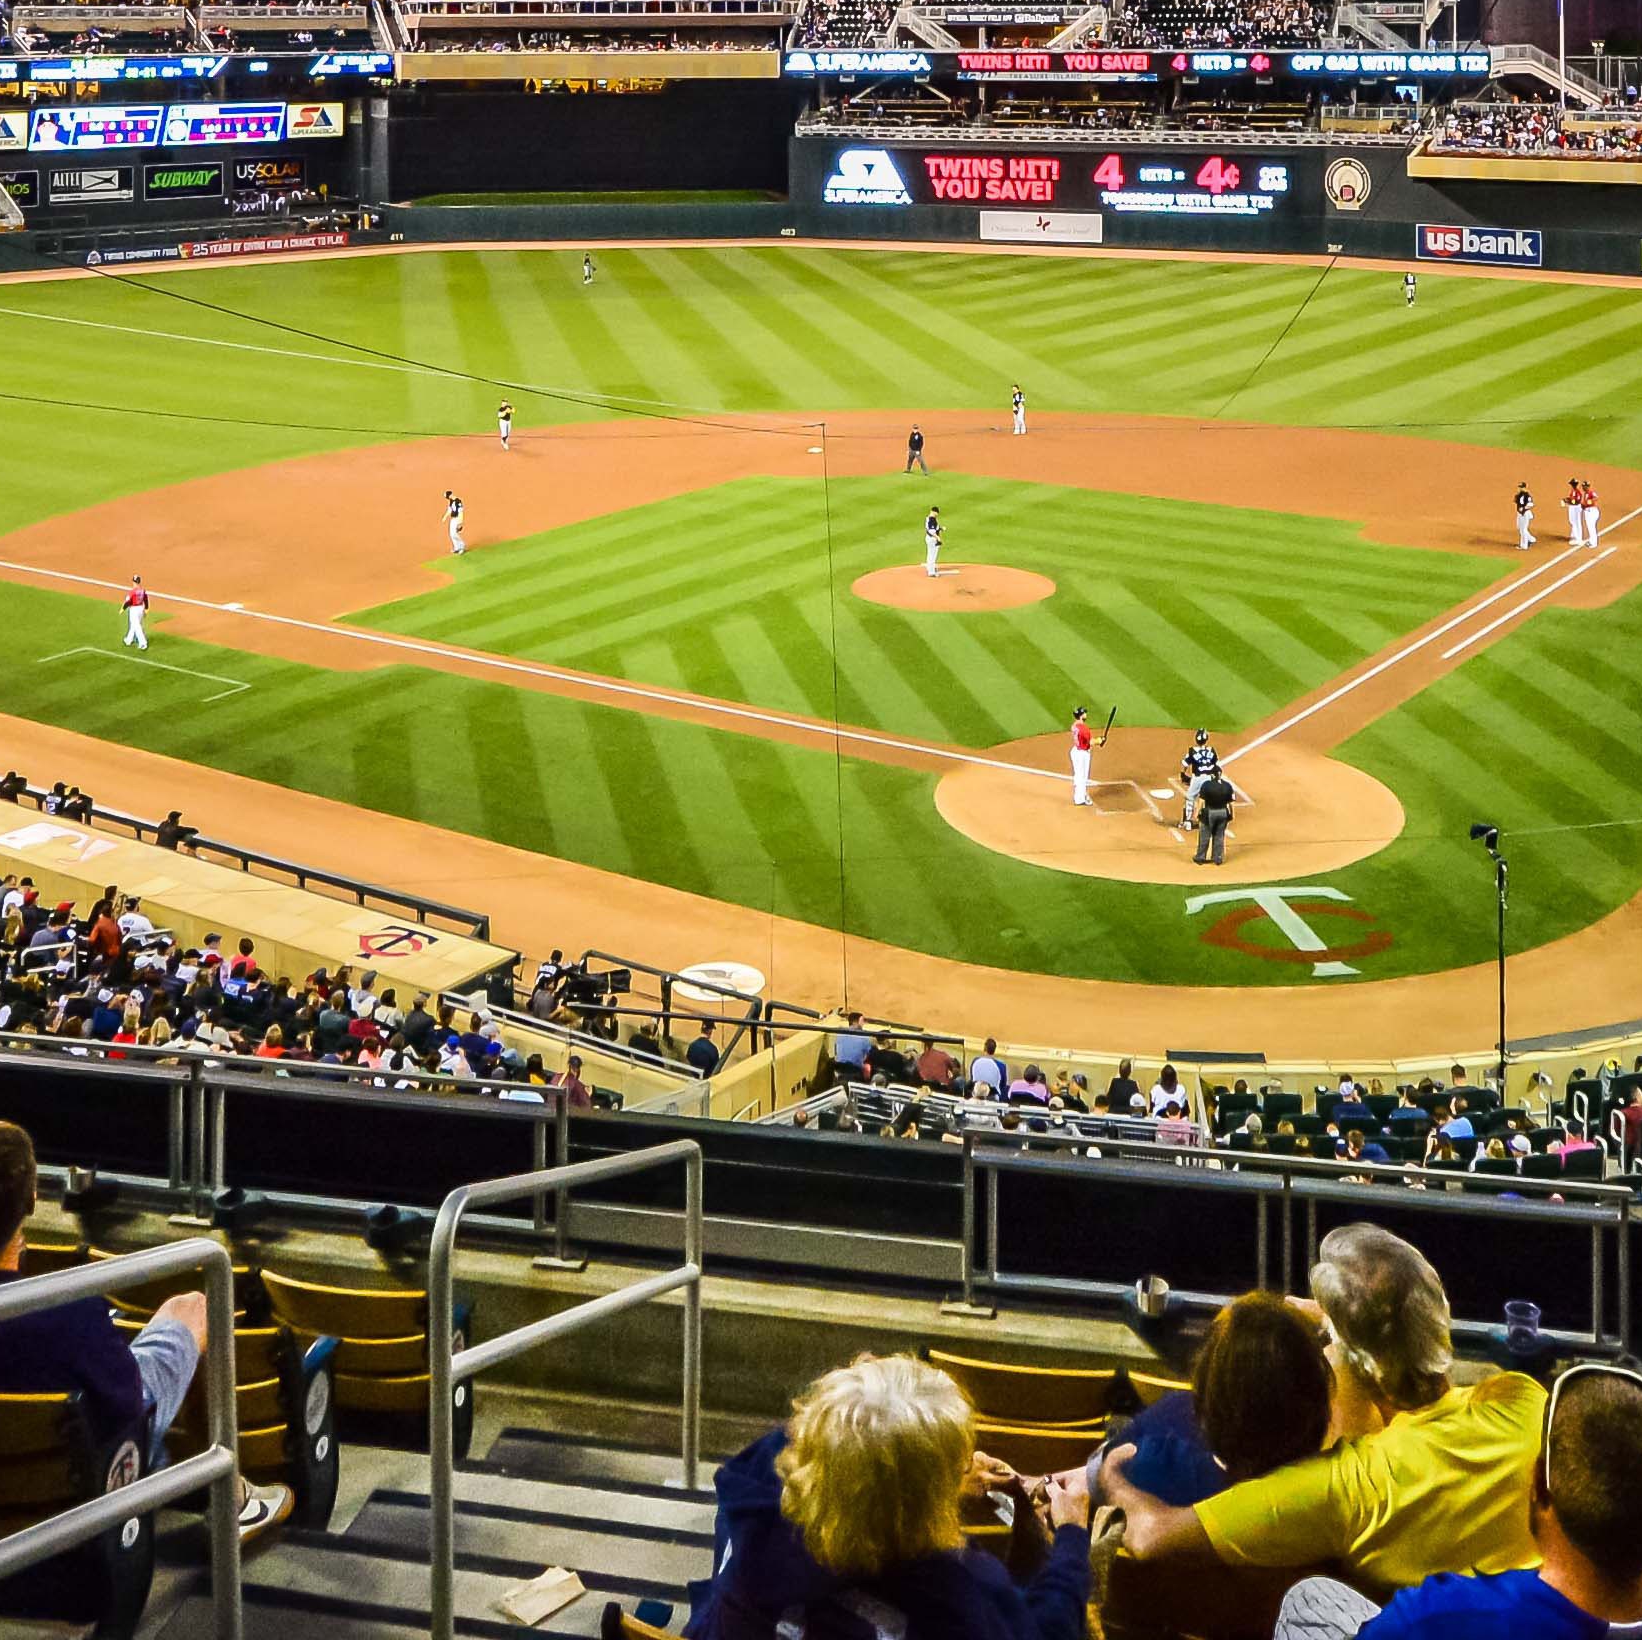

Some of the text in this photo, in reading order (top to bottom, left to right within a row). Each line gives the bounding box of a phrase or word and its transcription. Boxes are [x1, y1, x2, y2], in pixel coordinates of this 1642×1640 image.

[816, 53, 931, 71] SUPERAMERICA
[958, 53, 1014, 71] TWINS
[1015, 53, 1050, 71] HIT!
[1064, 54, 1097, 71] YOU
[1101, 54, 1149, 71] SAVE!
[1171, 54, 1187, 71] 4
[1292, 55, 1324, 71] OFF
[149, 169, 219, 189] SUBWAY
[925, 157, 1060, 181] TWINS HIT!
[1093, 153, 1125, 191] 4
[931, 178, 1053, 201] YOU SAVE!
[193, 243, 208, 256] 25
[210, 243, 232, 255] YEARS
